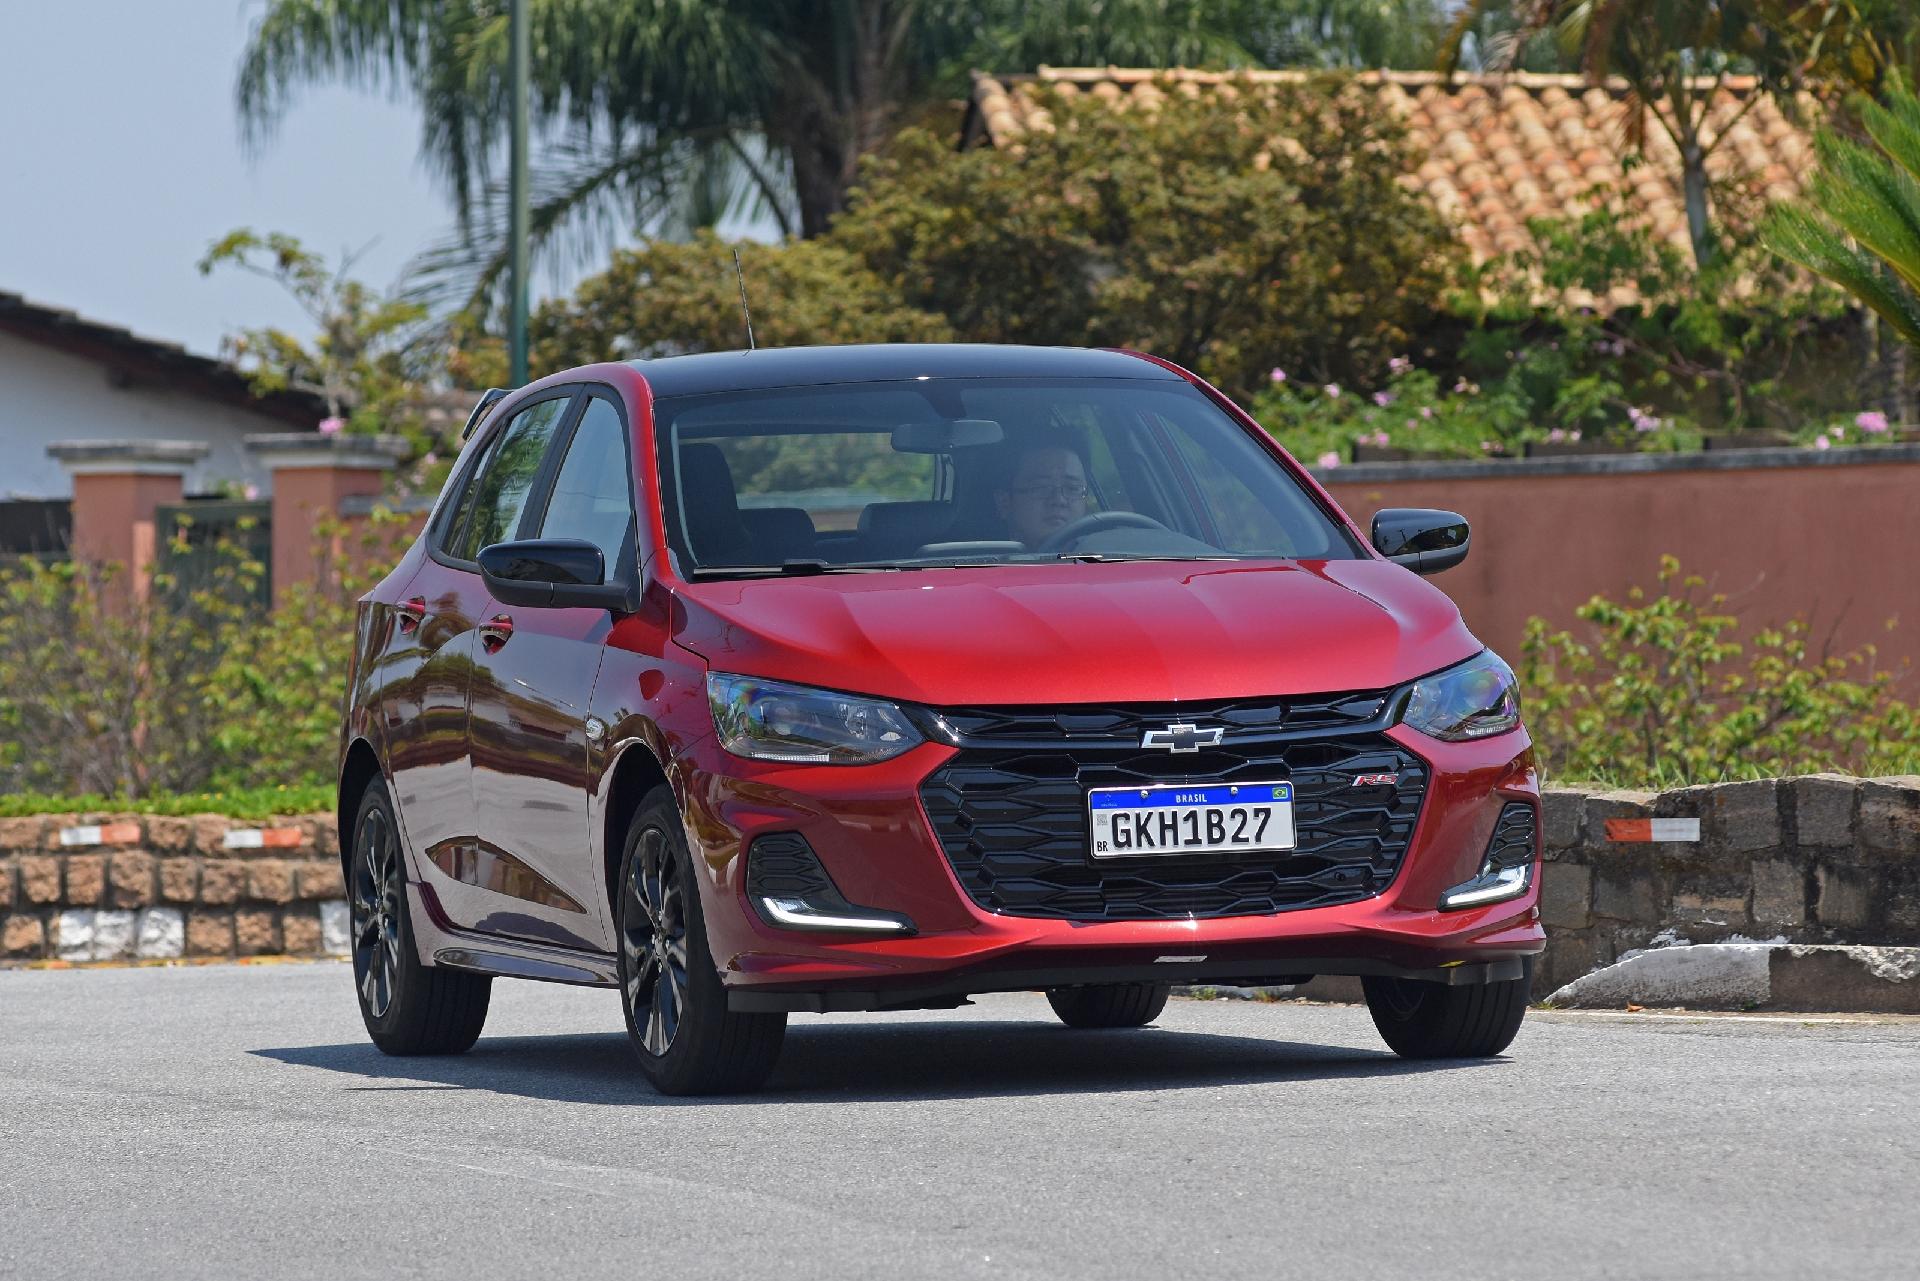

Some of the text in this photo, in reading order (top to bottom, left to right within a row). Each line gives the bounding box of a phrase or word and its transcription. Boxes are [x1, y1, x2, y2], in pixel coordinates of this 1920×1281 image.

[1352, 774, 1397, 786] RS
[1175, 794, 1207, 803] BRASIL
[1111, 807, 1272, 849] GKH1B27
[1097, 841, 1108, 852] BR
